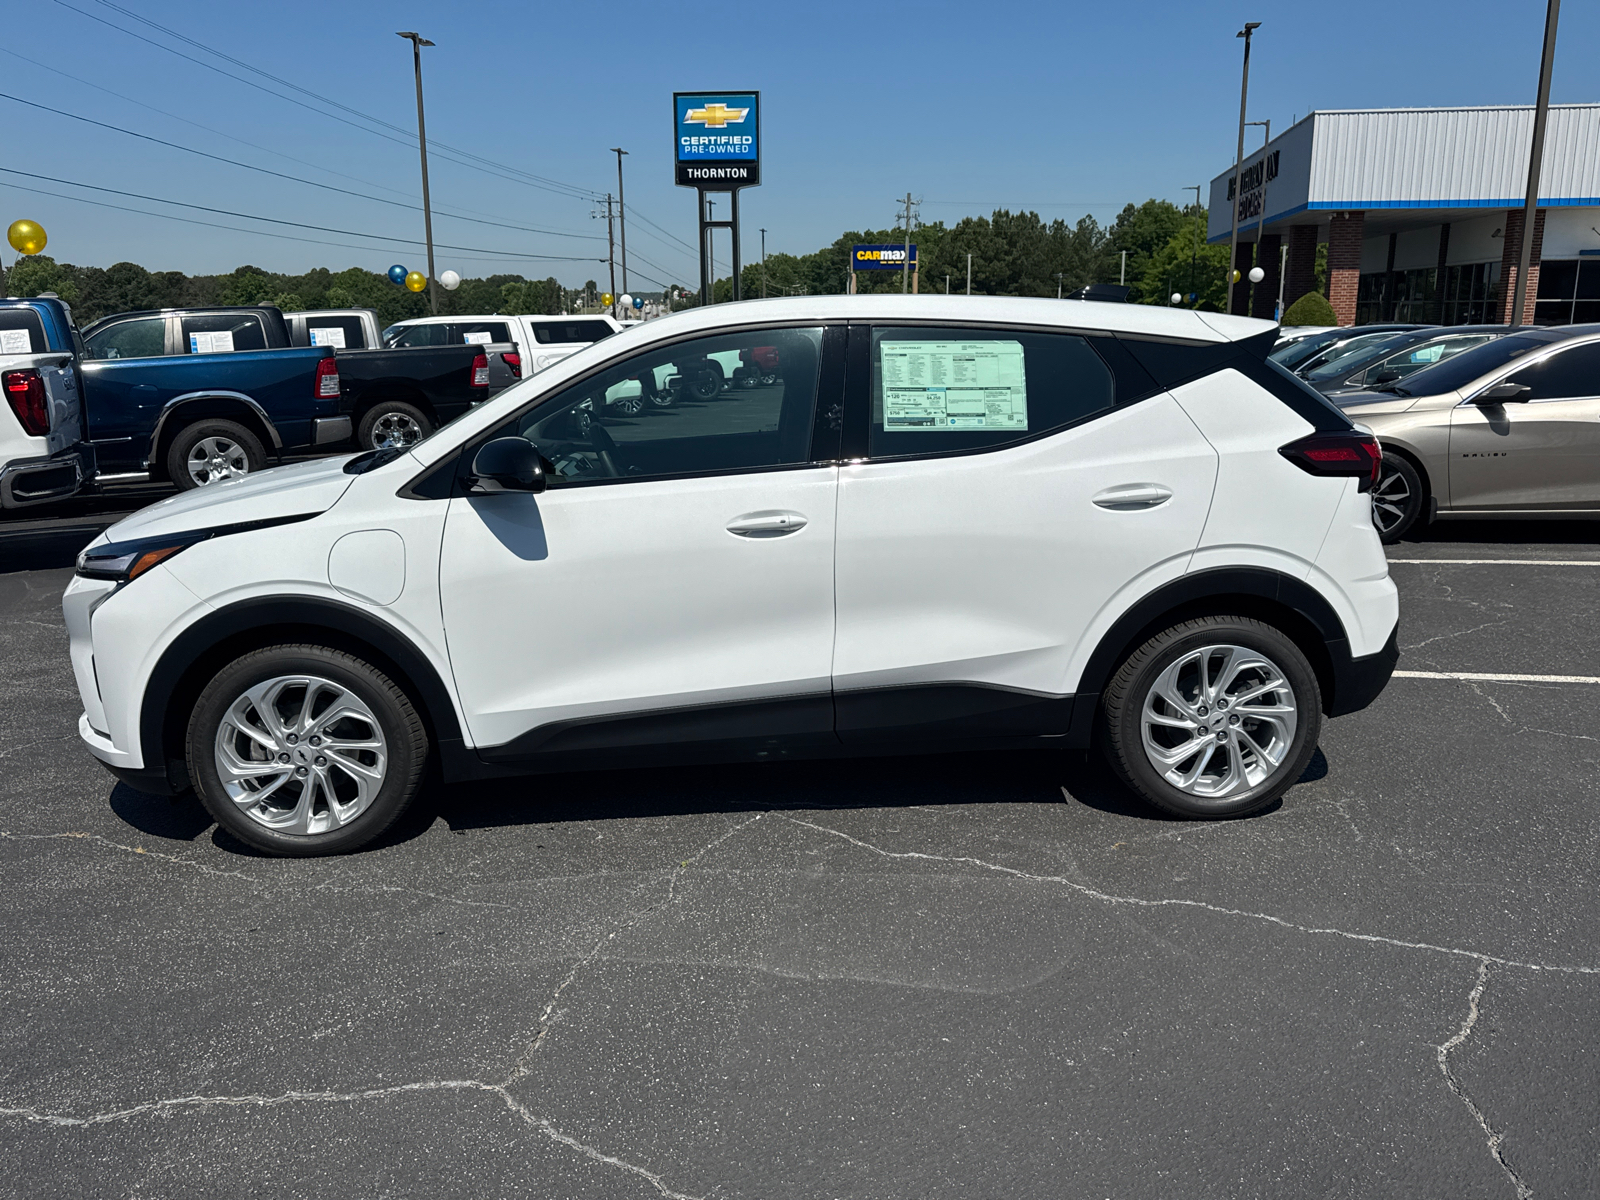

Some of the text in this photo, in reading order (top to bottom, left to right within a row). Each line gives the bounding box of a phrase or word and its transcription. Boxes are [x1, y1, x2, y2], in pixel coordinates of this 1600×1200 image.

[681, 136, 752, 145] CERTIFIED
[685, 145, 749, 153] PRE-OWNED
[687, 168, 747, 178] THORNTON
